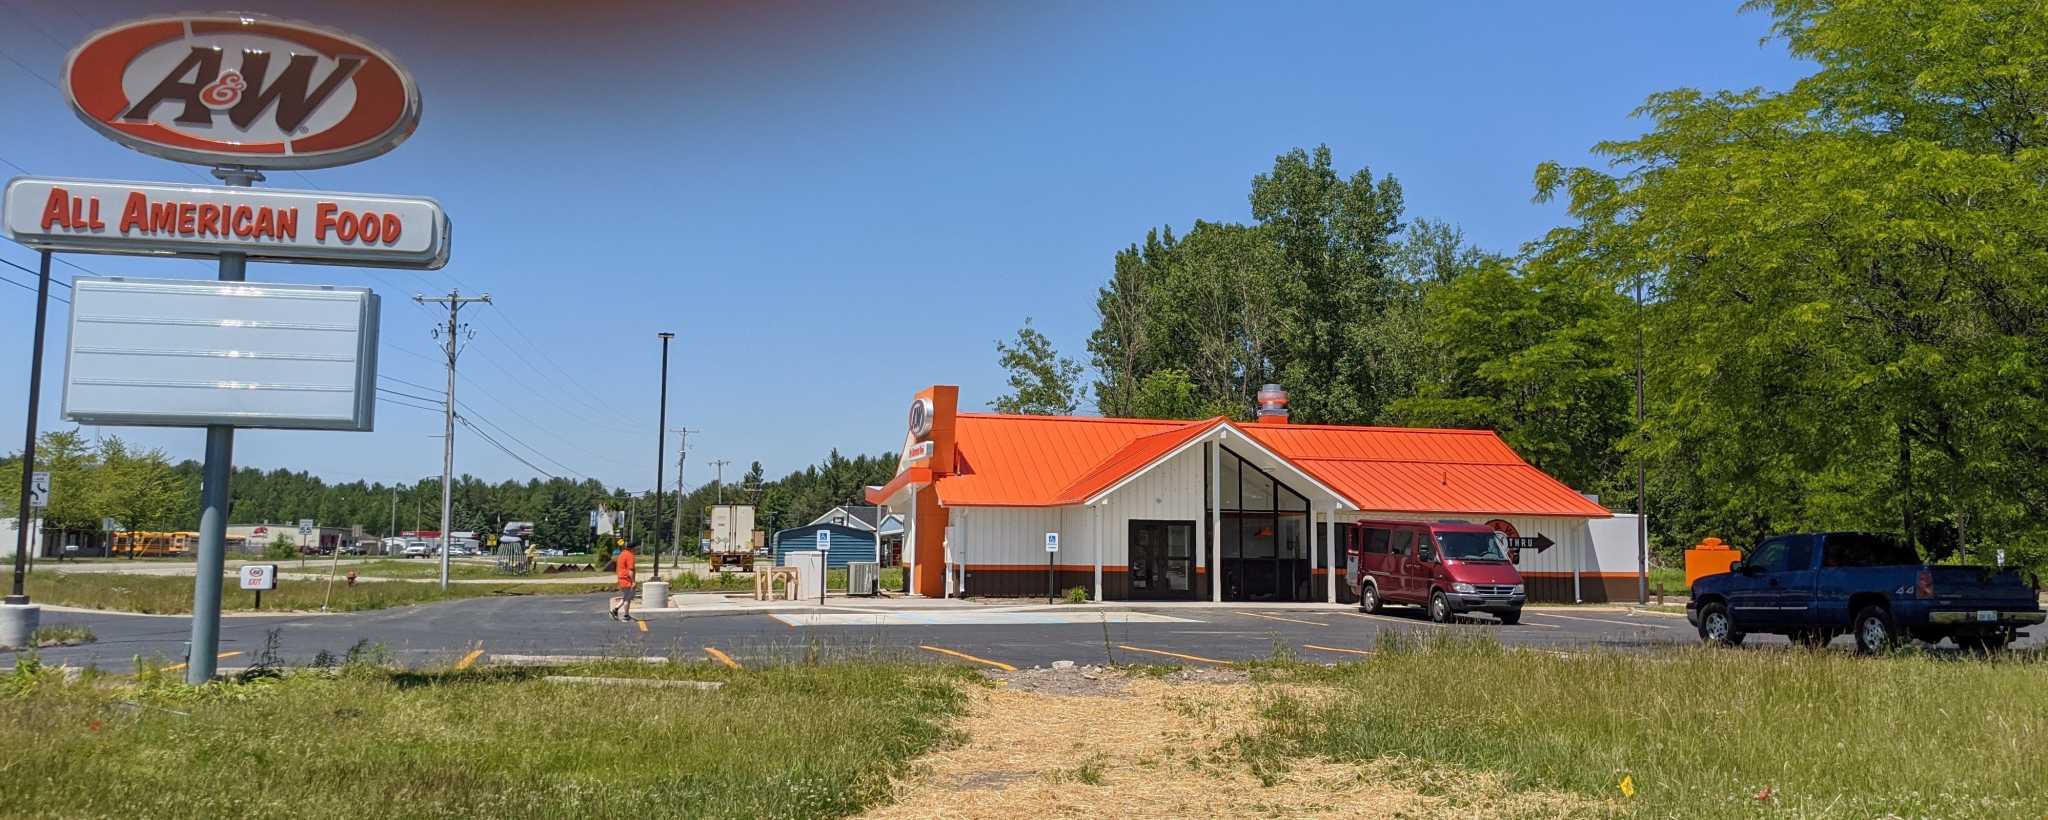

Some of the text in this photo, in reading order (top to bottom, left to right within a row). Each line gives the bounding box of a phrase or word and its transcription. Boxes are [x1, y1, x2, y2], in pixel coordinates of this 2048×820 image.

[122, 45, 363, 133] A&W
[1508, 538, 1533, 548] THRU
[1895, 585, 1915, 595] 44
